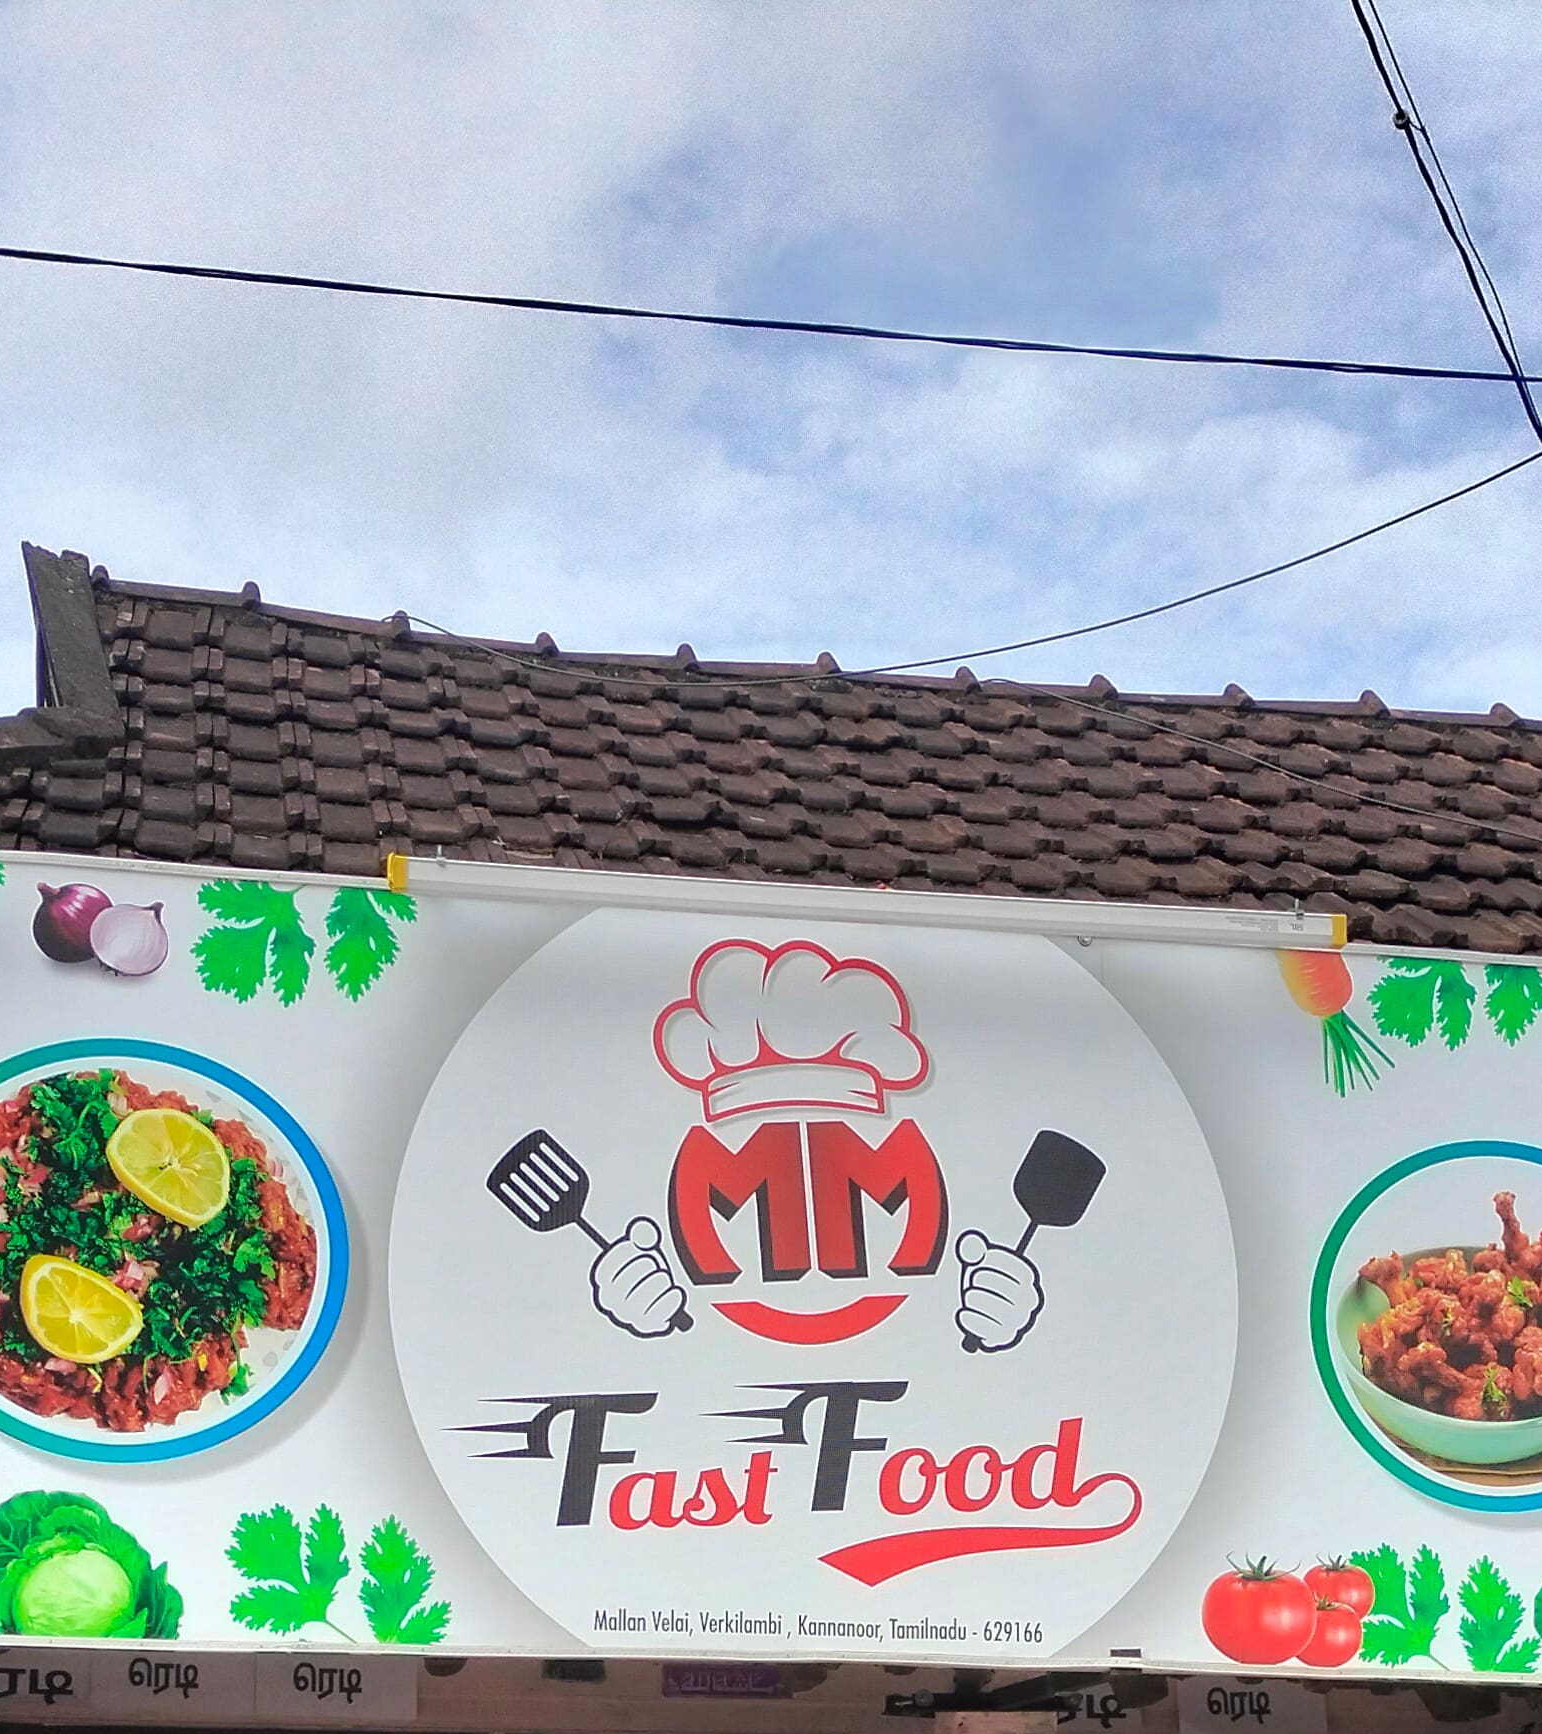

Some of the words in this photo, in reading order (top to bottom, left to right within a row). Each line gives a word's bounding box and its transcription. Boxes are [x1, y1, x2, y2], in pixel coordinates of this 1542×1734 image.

[667, 1119, 948, 1285] MM
[440, 1392, 778, 1530] Fast
[702, 1381, 1142, 1545] Food
[593, 1610, 647, 1634] Mallan
[651, 1613, 694, 1636] Velai,
[699, 1613, 783, 1636] Verkilambi
[797, 1616, 884, 1642] Kannanoor,
[889, 1619, 968, 1642] Tamilnadu
[983, 1621, 1044, 1644] 629166
[128, 1656, 199, 1703] ரெடி
[292, 1662, 363, 1702] ரெடி
[1207, 1686, 1271, 1723] ரெடி
